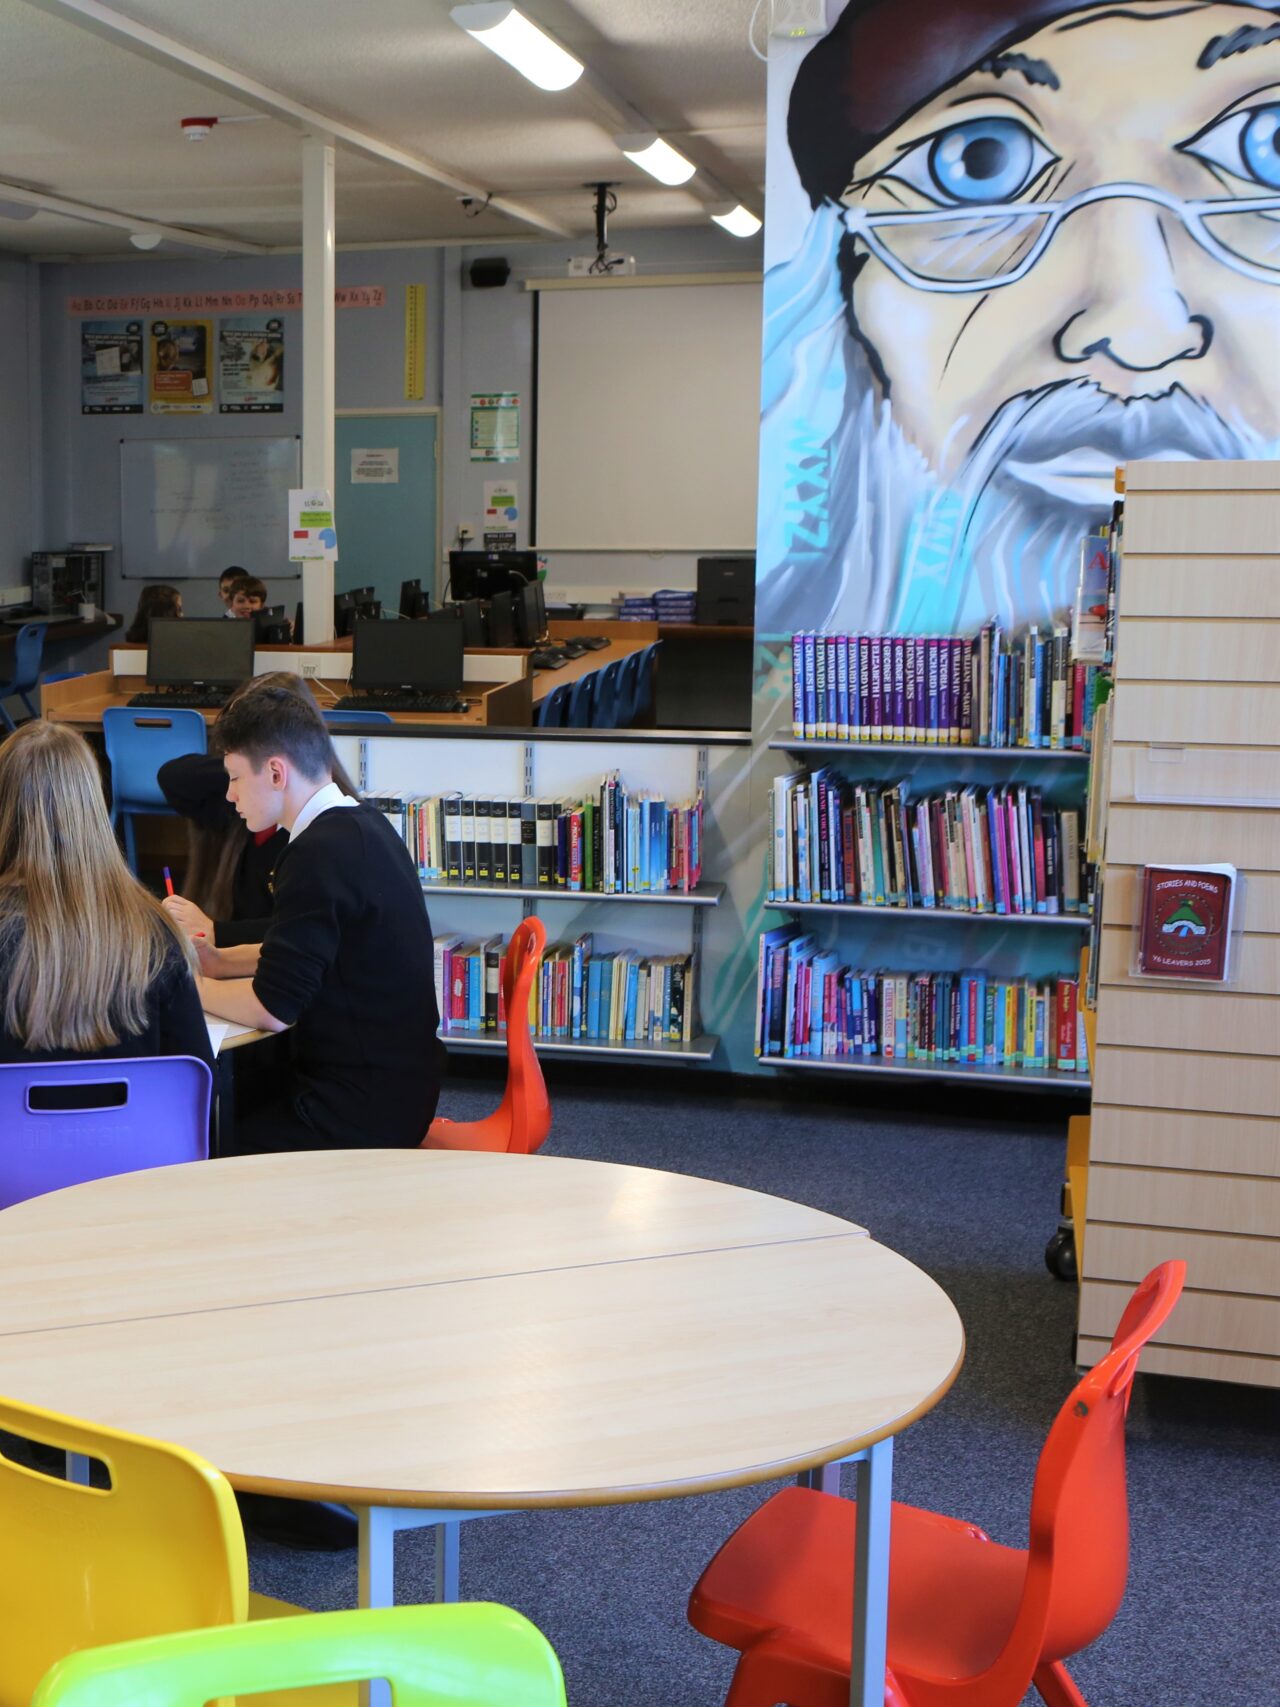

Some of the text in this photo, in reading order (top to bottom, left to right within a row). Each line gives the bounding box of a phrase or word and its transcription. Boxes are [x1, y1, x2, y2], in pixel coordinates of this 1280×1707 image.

[794, 643, 802, 709] ALFRED GREAT
[806, 644, 814, 684] CHARLES
[817, 645, 825, 688] EDWARD
[827, 645, 835, 683] EDWARD
[838, 644, 846, 683] EDWARD
[849, 643, 857, 695] EDWARD IV
[860, 645, 868, 684] EDWARD
[872, 645, 880, 693] ELIZABETH
[883, 646, 891, 682] GEORGE
[895, 646, 903, 693] GEORGE IV
[905, 647, 914, 700] KING JAMES
[916, 646, 924, 675] JAMES
[929, 647, 937, 688] RICHARD
[939, 648, 947, 691] VICTORIA
[952, 647, 960, 695] WILLIAM IV
[963, 646, 971, 683] WILLIAM
[963, 691, 971, 715] MARY
[820, 812, 828, 840] VOICES
[1156, 879, 1219, 894] STORIES AND POEMS
[1162, 958, 1193, 967] LEAVERS
